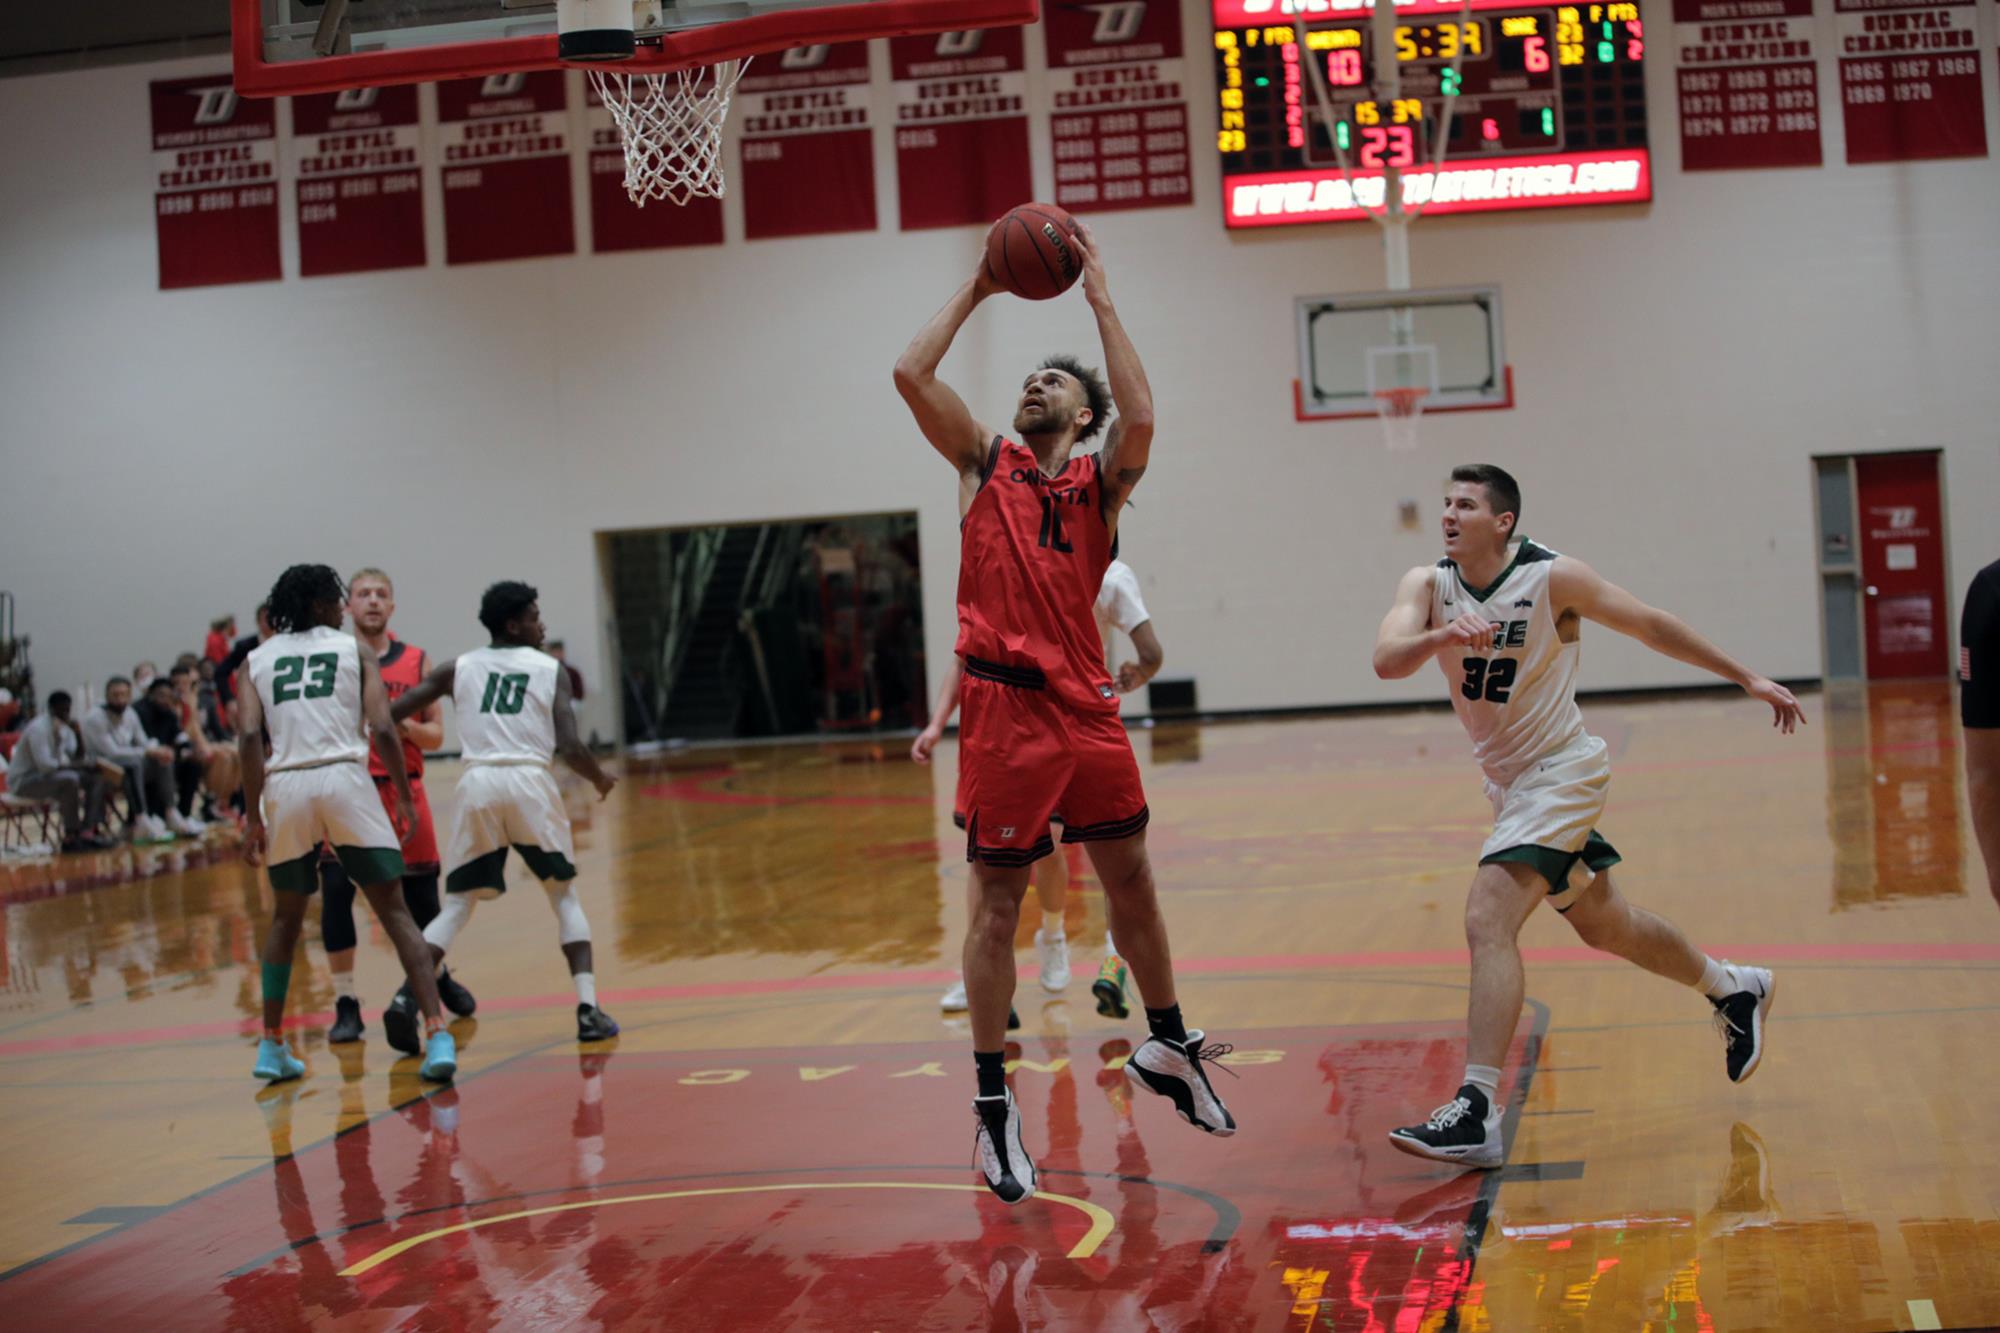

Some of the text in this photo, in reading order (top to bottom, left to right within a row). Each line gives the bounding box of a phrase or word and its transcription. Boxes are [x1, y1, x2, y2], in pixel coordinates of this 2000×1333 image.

[1701, 22, 1787, 42] SUNYAC
[1863, 11, 1950, 31] SUNYAC
[1524, 37, 1550, 73] 6
[1682, 40, 1810, 62] CHAMPIONS
[1844, 30, 1973, 52] CHAMPIONS
[1361, 126, 1414, 167] 23
[273, 652, 339, 705] 23
[480, 672, 530, 714] 10
[1461, 657, 1518, 704] 32
